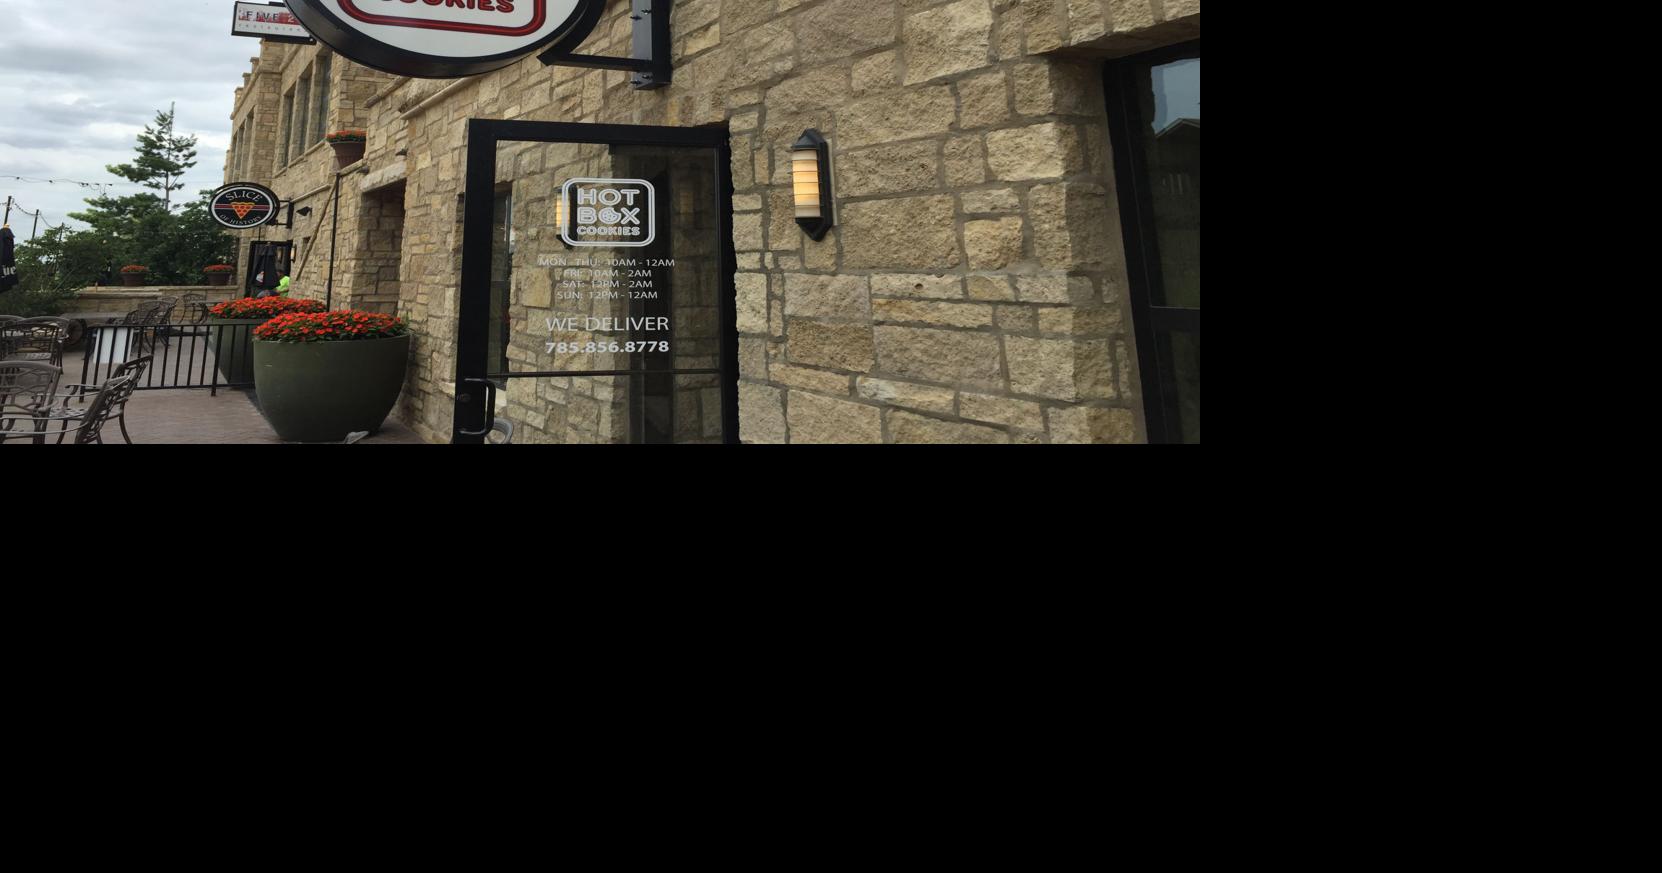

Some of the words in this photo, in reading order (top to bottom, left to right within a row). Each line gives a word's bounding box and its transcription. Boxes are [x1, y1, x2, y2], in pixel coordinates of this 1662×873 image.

[246, 10, 280, 21] FIVE
[225, 190, 263, 202] SLICE
[577, 188, 640, 205] HOT
[229, 216, 262, 225] HISTORY
[577, 206, 640, 225] BOX
[577, 226, 640, 236] COOKIES
[538, 258, 567, 266] MON
[607, 258, 636, 267] 10AM
[646, 258, 675, 267] 12AM
[563, 269, 583, 277] FRI:
[589, 269, 619, 277] 10AM
[628, 269, 652, 278] 2AM
[562, 280, 585, 288] SAT:
[591, 280, 620, 288] 12PM
[629, 280, 653, 288] 2AM
[556, 291, 583, 299] SUN:
[590, 291, 618, 299] 12PM
[629, 291, 658, 299] 12AM
[546, 317, 579, 332] WE
[585, 316, 669, 331] DELIVER
[545, 341, 669, 354] 785.856.8778
